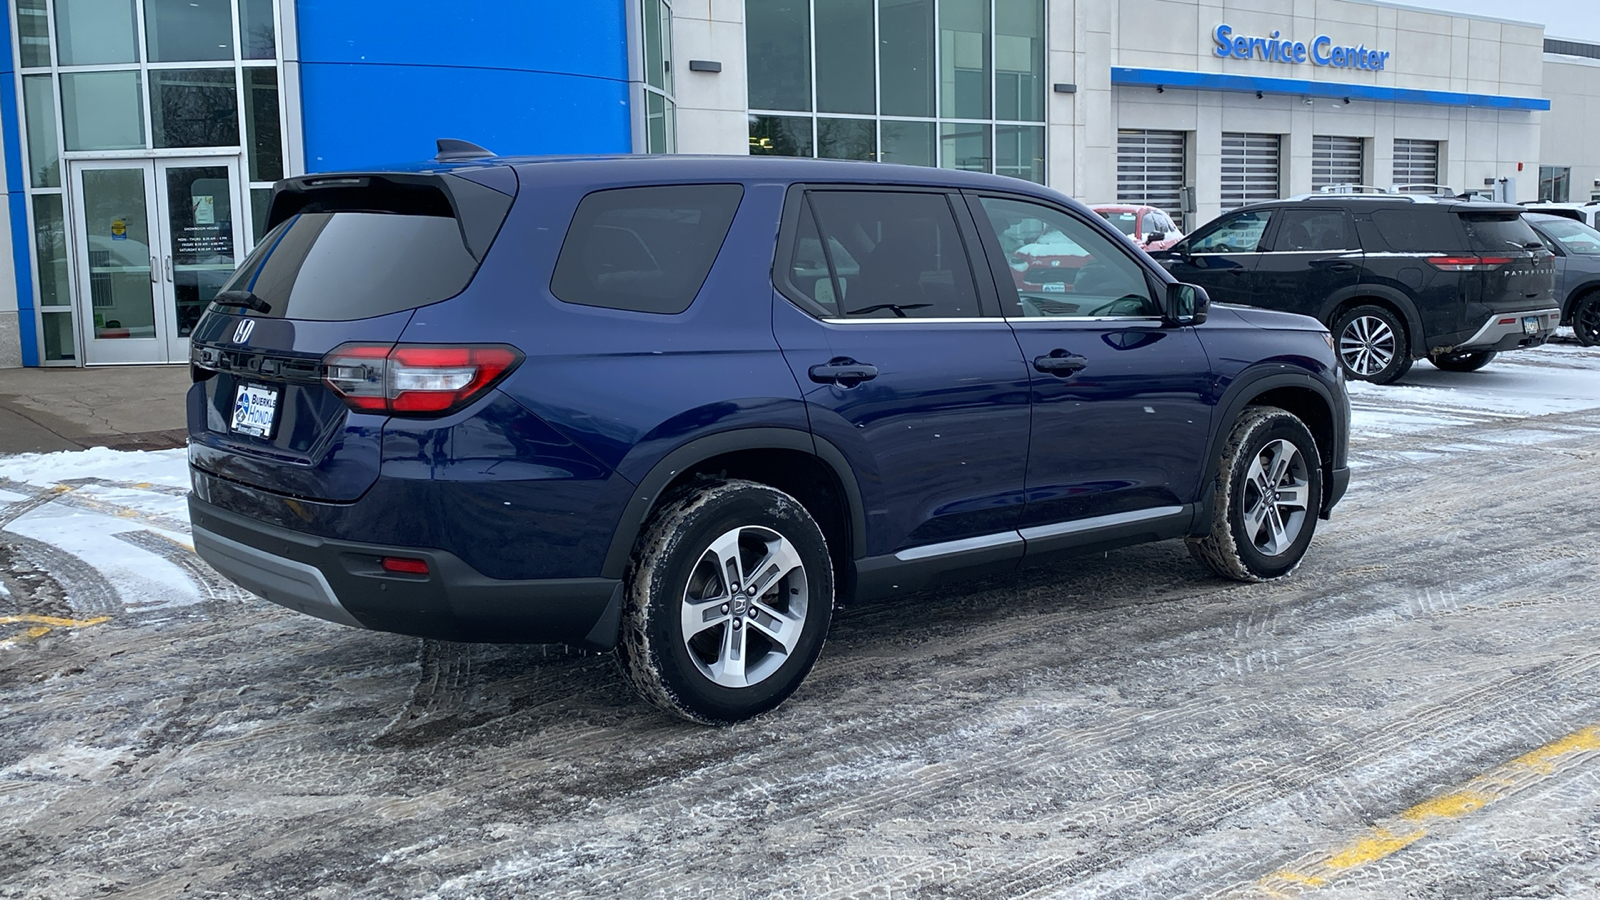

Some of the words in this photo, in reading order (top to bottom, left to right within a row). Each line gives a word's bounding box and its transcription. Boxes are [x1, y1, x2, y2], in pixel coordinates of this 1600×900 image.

[1213, 24, 1306, 63] Service
[1310, 34, 1389, 71] Center
[251, 394, 277, 409] BUERKLE
[248, 405, 274, 425] HONDA
